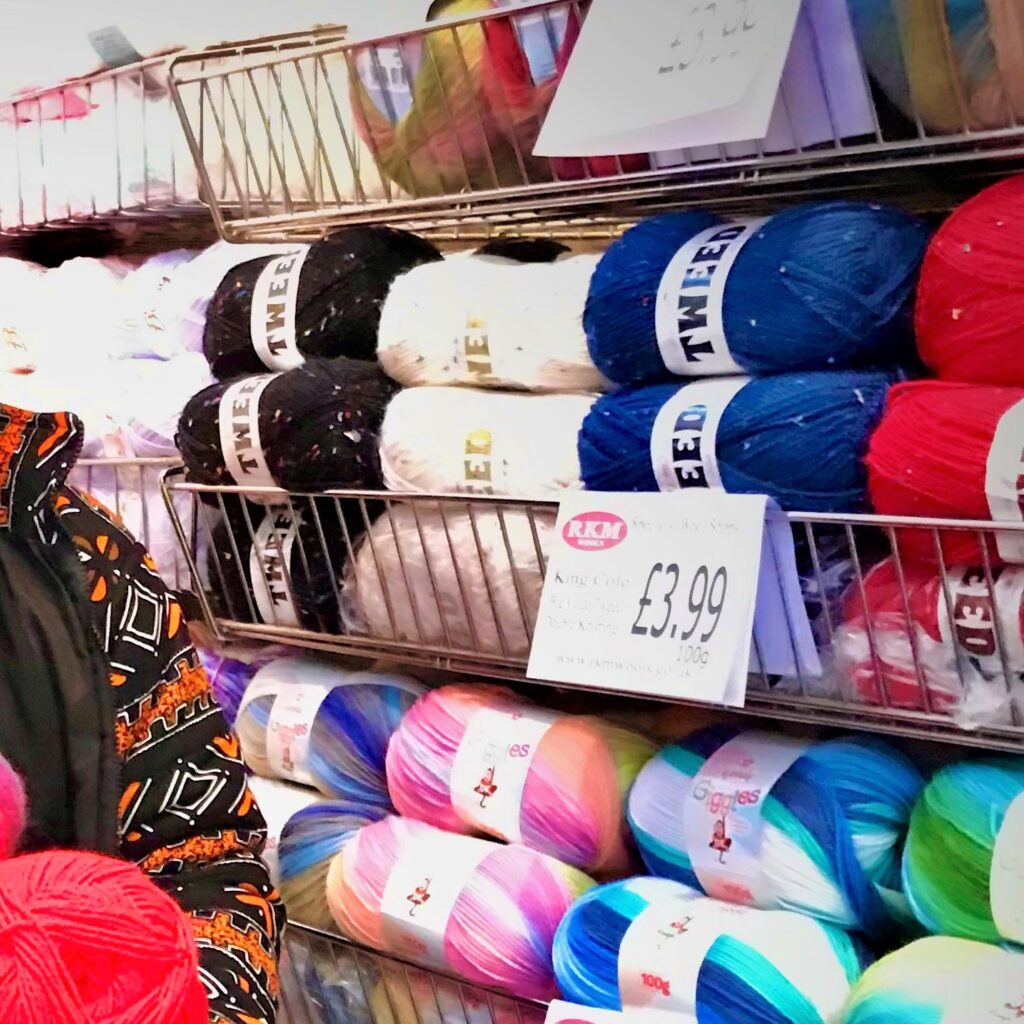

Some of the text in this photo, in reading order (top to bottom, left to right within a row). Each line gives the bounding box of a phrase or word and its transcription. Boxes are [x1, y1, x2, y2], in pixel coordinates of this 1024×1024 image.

[265, 250, 301, 357] TWEE
[677, 225, 747, 363] TWEED
[231, 377, 260, 475] TWEE
[672, 403, 708, 488] EED
[264, 512, 292, 606] TWEE
[567, 519, 624, 541] RKM
[553, 570, 588, 587] King
[631, 561, 728, 643] £3.99
[675, 646, 710, 668] 100g
